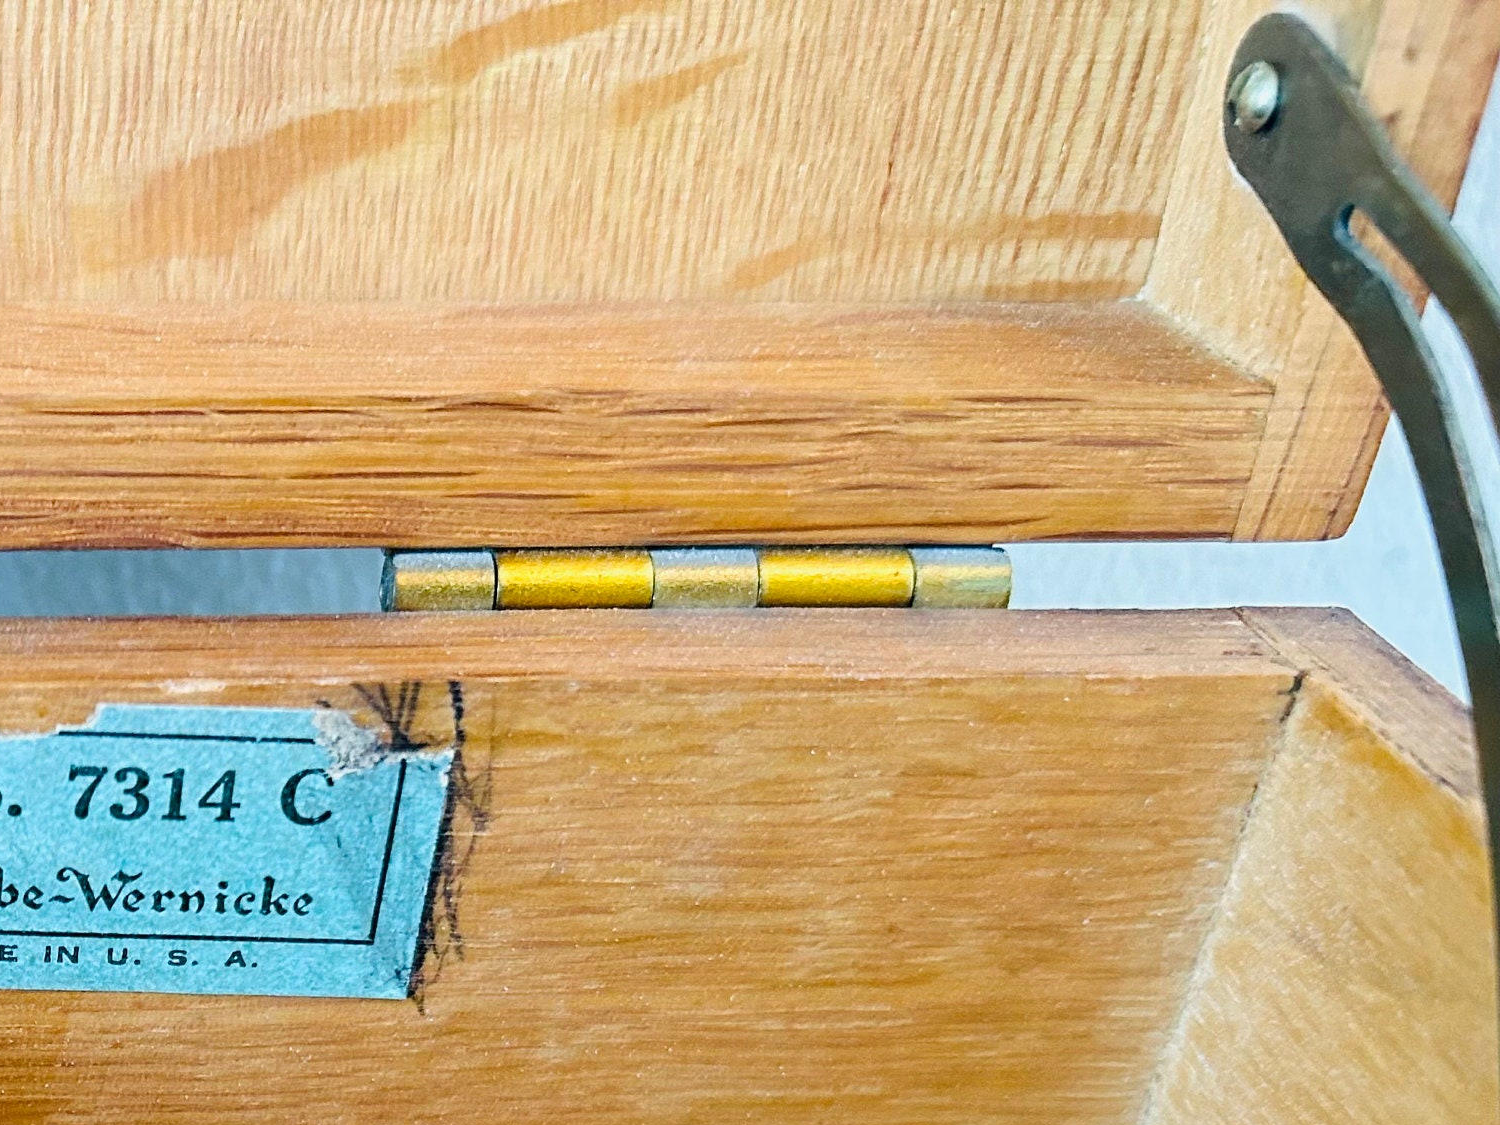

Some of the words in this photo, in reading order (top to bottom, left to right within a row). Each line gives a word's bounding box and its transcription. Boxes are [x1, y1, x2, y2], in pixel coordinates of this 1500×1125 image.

[68, 765, 241, 824] 7314
[280, 768, 333, 826] C
[43, 945, 80, 966] IN
[106, 946, 141, 967] U.
[167, 947, 199, 968] S.
[225, 948, 259, 969] A.
